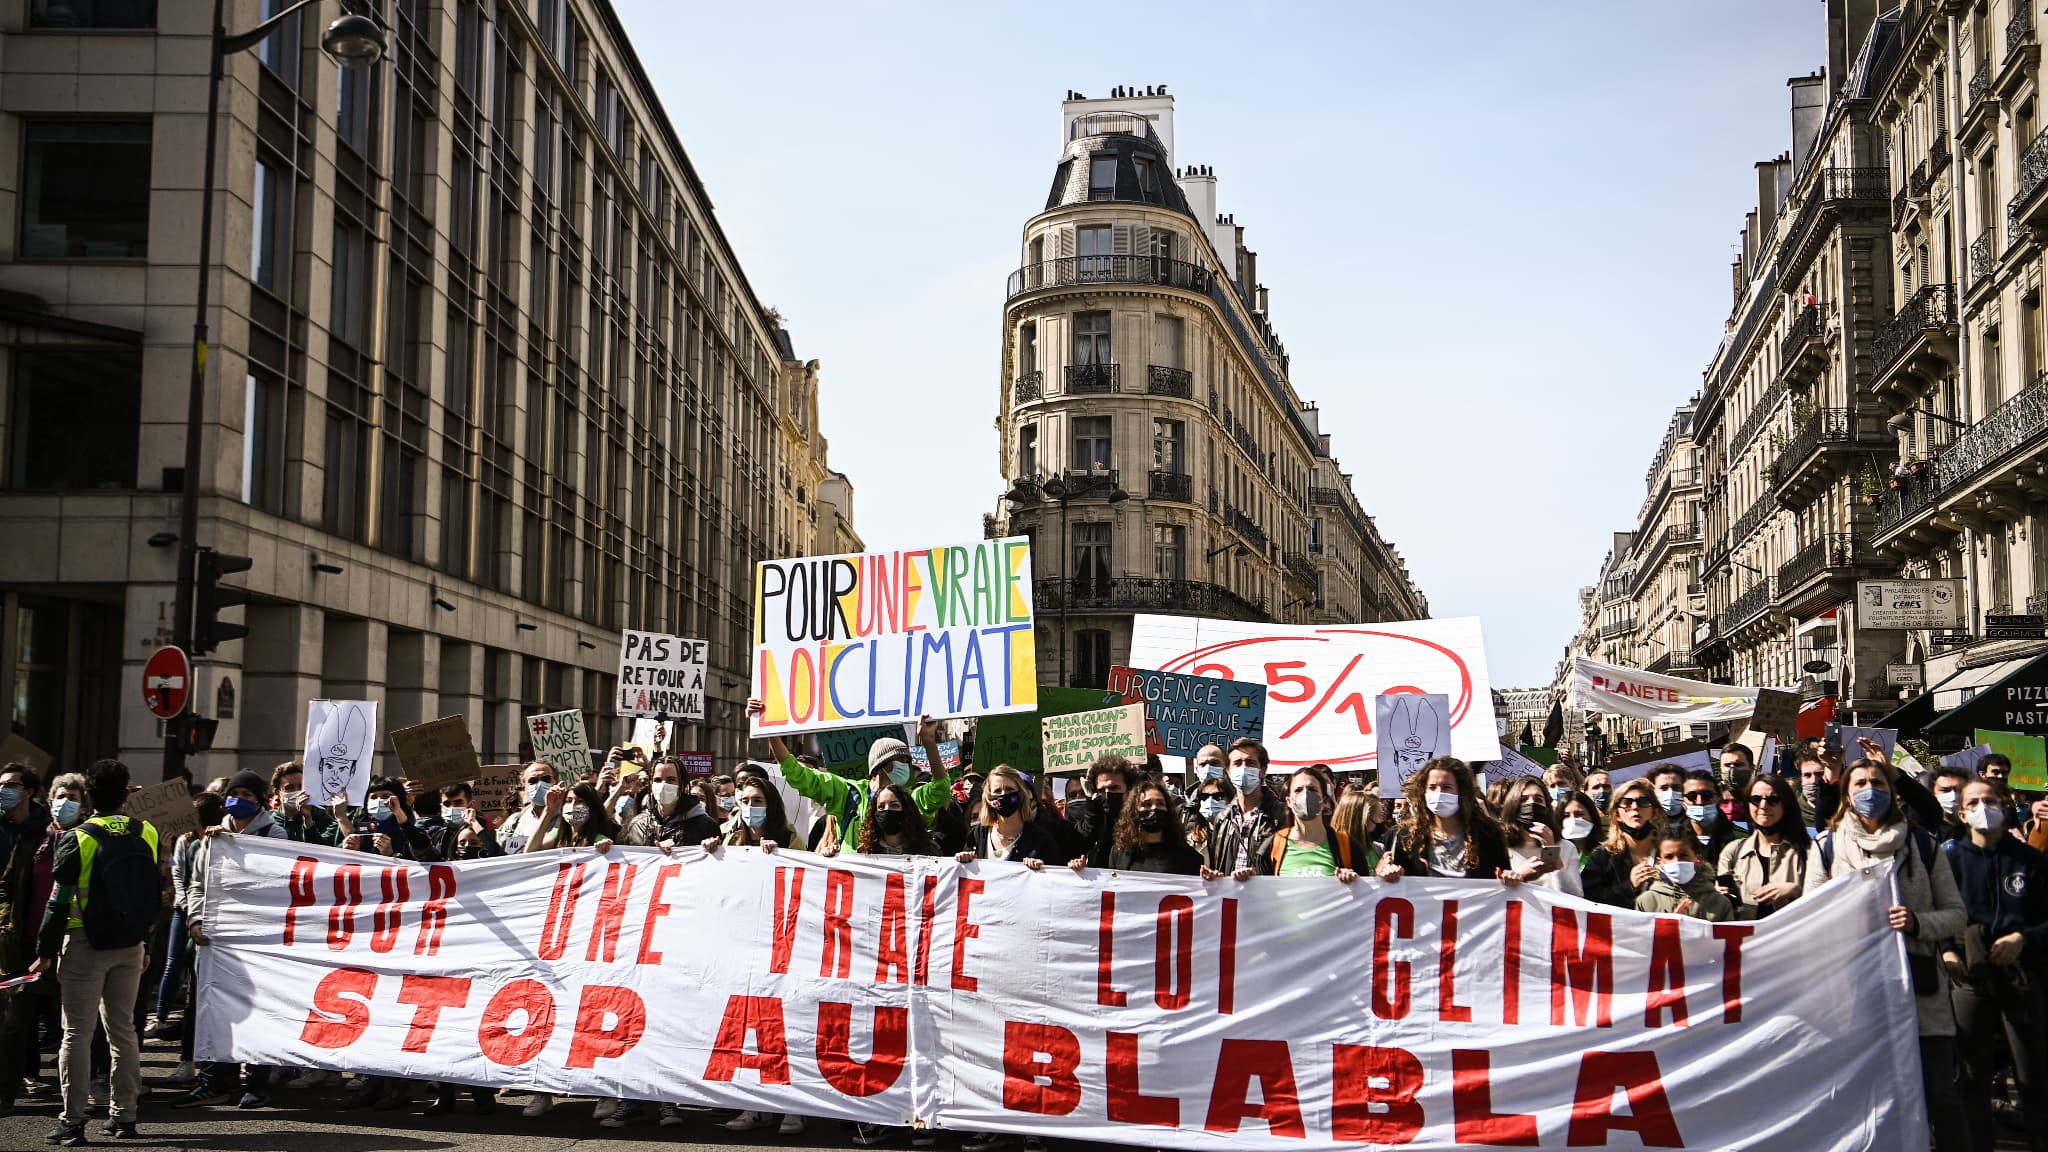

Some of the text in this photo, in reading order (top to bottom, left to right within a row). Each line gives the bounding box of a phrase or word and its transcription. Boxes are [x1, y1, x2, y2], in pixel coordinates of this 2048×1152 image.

[760, 539, 1031, 644] POUR UNE VRAIE
[624, 633, 706, 665] PAS DE
[622, 665, 704, 690] RETOUR À
[758, 624, 1032, 728] LOI CLIMAT
[1114, 673, 1220, 705] URGENCE
[1591, 675, 1681, 704] PLANETE
[1049, 708, 1128, 730] MARQUONS
[1138, 701, 1241, 731] LIMATIQUE
[2005, 711, 2048, 725] PAST
[541, 731, 582, 751] MORE
[1082, 733, 1133, 750] SOYONS
[541, 749, 588, 767] MPTY
[1047, 753, 1074, 768] PAS
[1076, 751, 1095, 765] LA
[283, 856, 1755, 1029] POUR UNE VRAIE LOI CLIMAT
[298, 967, 1686, 1149] STOP AU BLABLA
